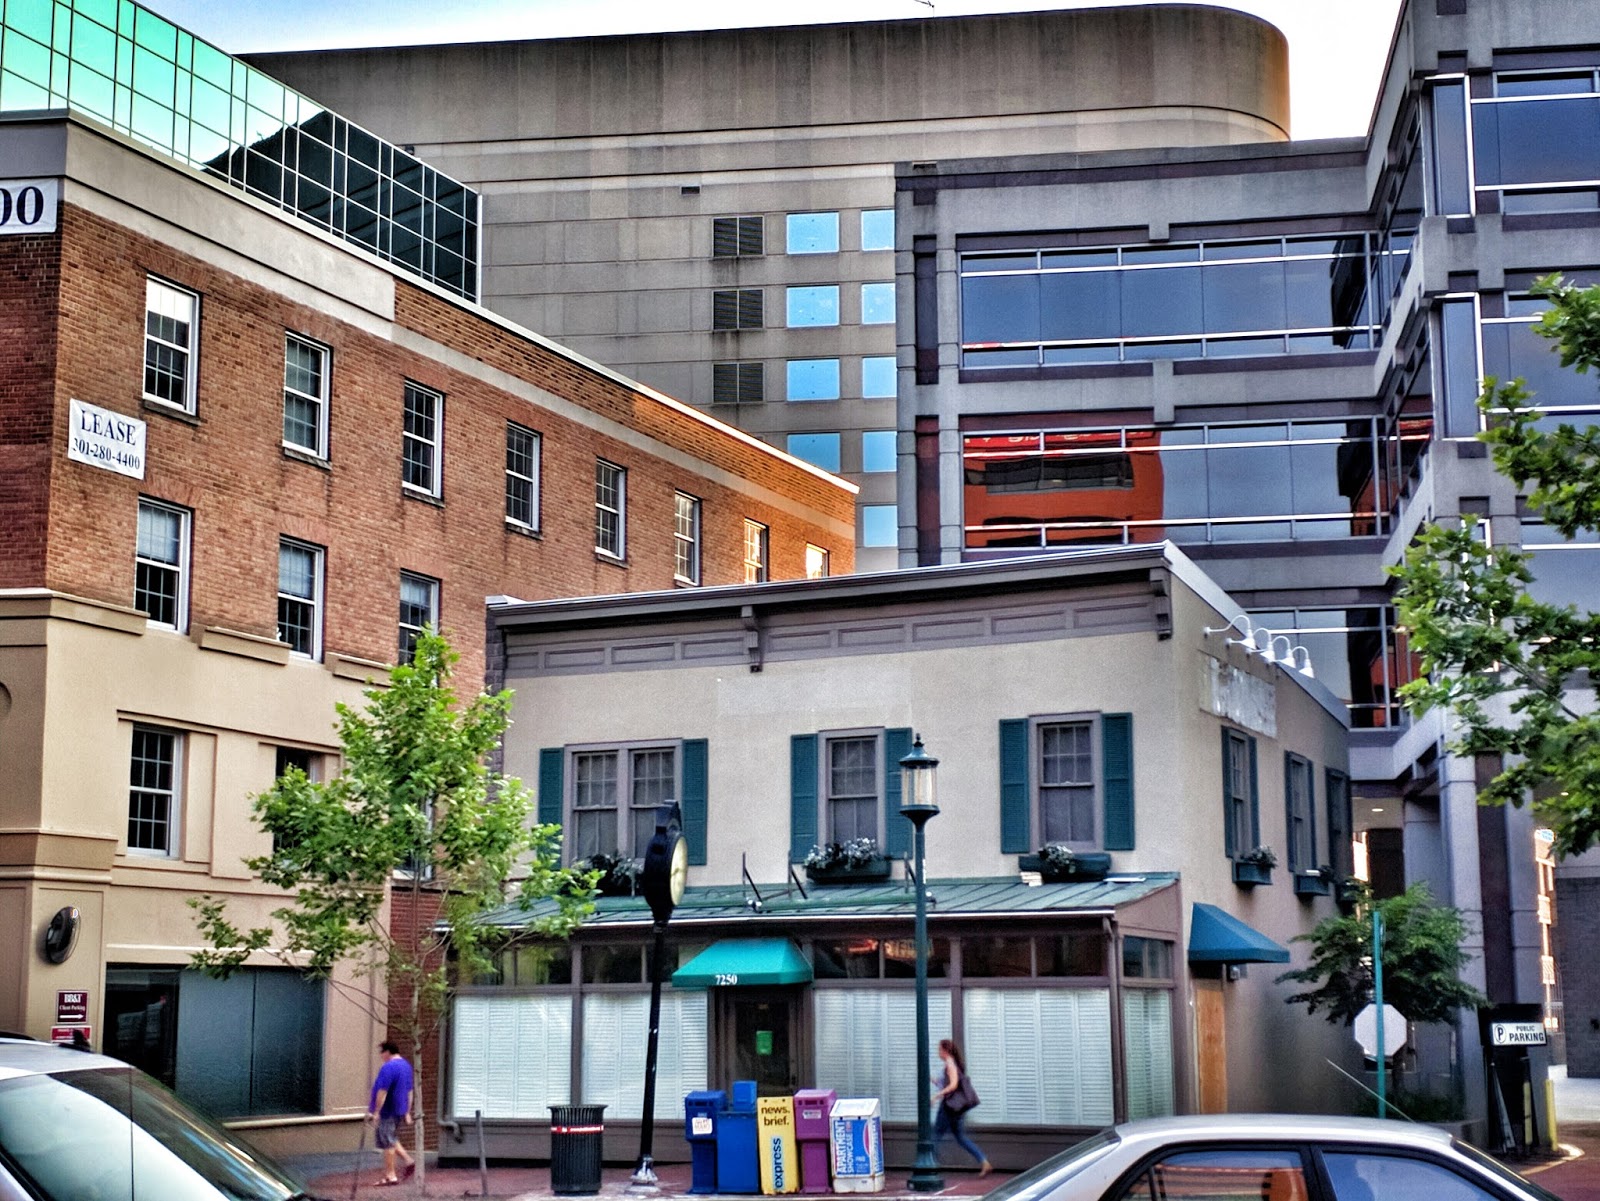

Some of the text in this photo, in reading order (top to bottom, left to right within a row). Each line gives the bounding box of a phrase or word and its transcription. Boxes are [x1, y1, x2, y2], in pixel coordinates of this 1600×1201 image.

[80, 409, 137, 446] LEASE
[72, 438, 141, 470] 301-280-4400
[715, 974, 738, 986] 7250
[1497, 1027, 1504, 1040] P
[1509, 1033, 1544, 1042] PARKING
[761, 1105, 790, 1114] news.
[763, 1116, 790, 1126] brief.
[836, 1121, 846, 1173] APARTMENT
[846, 1133, 854, 1173] SHOWCASE
[774, 1137, 784, 1189] express
